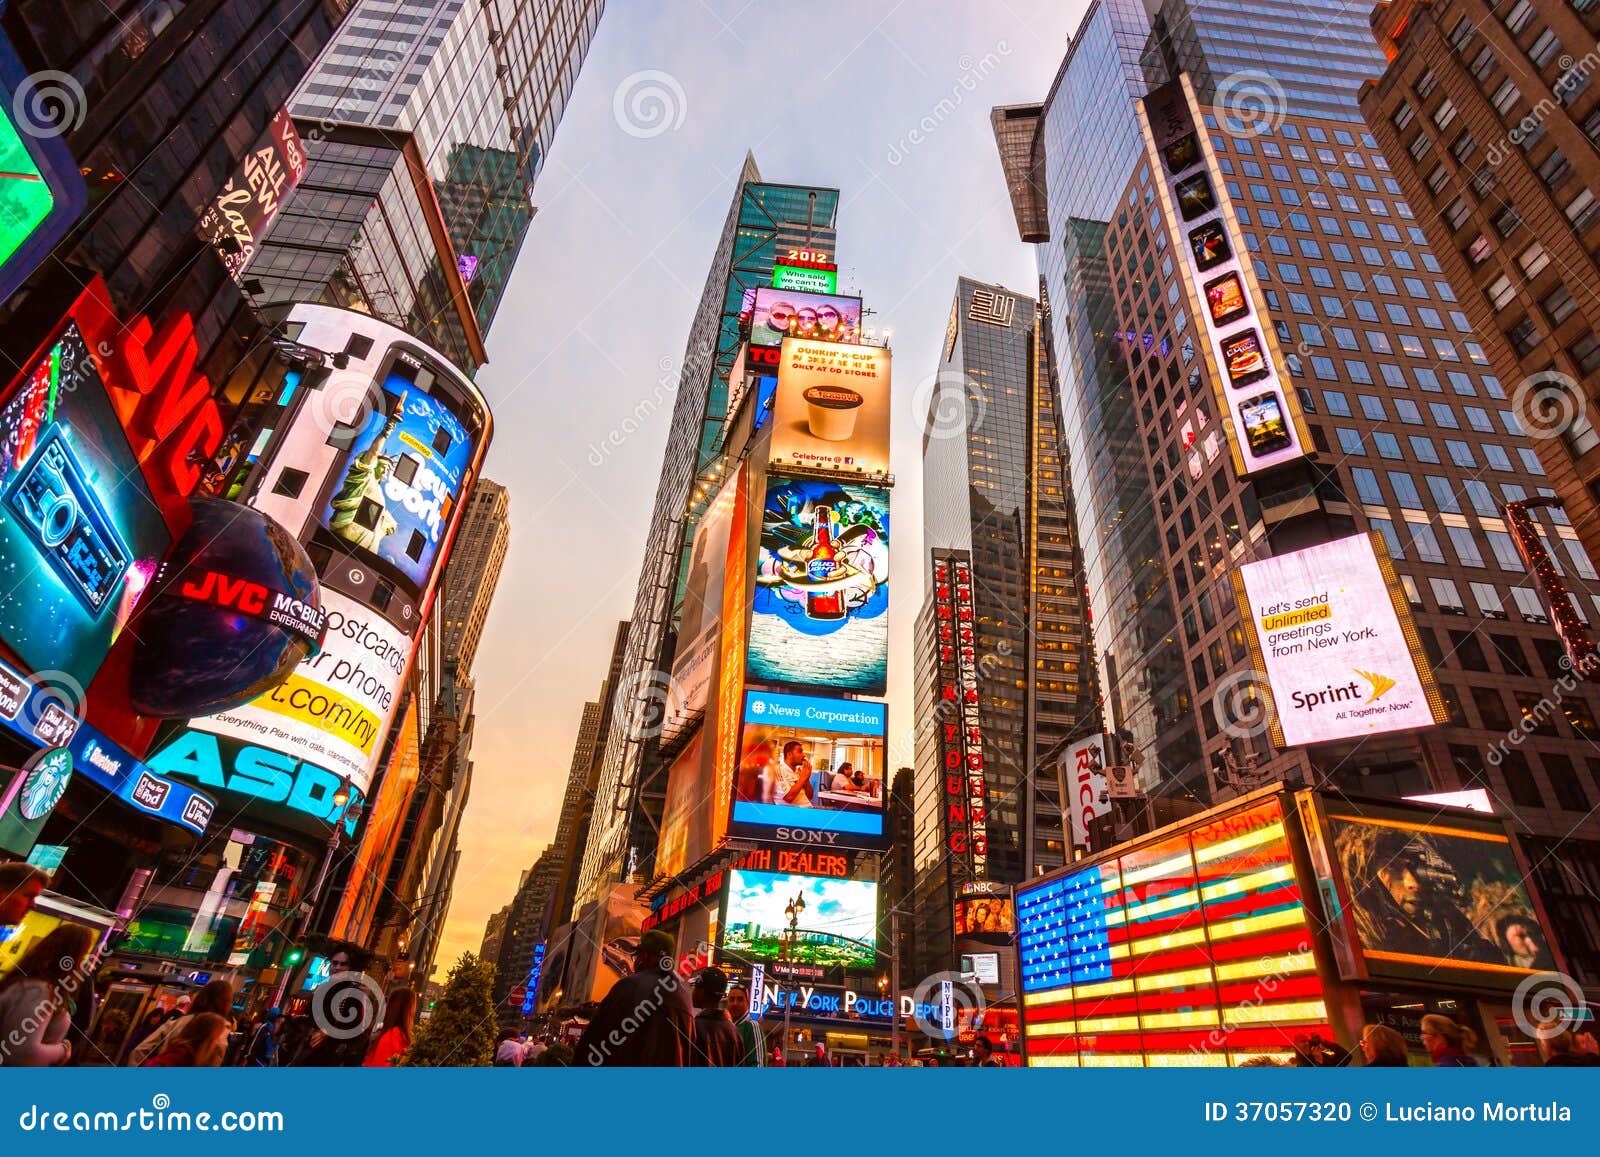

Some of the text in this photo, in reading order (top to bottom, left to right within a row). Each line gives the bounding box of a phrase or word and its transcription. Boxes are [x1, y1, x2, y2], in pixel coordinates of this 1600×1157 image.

[257, 145, 286, 197] ALL
[787, 249, 827, 264] 2012
[785, 270, 826, 281] Who said
[792, 363, 814, 371] ONLY
[792, 451, 833, 463] Celebrate
[182, 571, 269, 615] JVC
[1260, 591, 1329, 618] Let's send
[273, 593, 325, 630] MOBILE
[1264, 605, 1329, 631] Unlimited
[319, 605, 405, 676] ostcards
[1267, 620, 1332, 647] greetings
[1271, 626, 1379, 658] from New York.
[327, 658, 392, 713] phone.
[1291, 680, 1362, 712] Sprint
[45, 710, 62, 726] Dual
[769, 703, 880, 725] News Corporation
[216, 712, 269, 735] Everything
[270, 727, 290, 741] Plan
[291, 732, 307, 746] with
[944, 723, 967, 853] YOUNG
[1075, 748, 1096, 844] RICO
[776, 827, 840, 844] SONY
[778, 851, 847, 877] DEALERS
[973, 883, 993, 893] NBC
[752, 965, 763, 1012] NYPD
[943, 982, 952, 1029] NYPD
